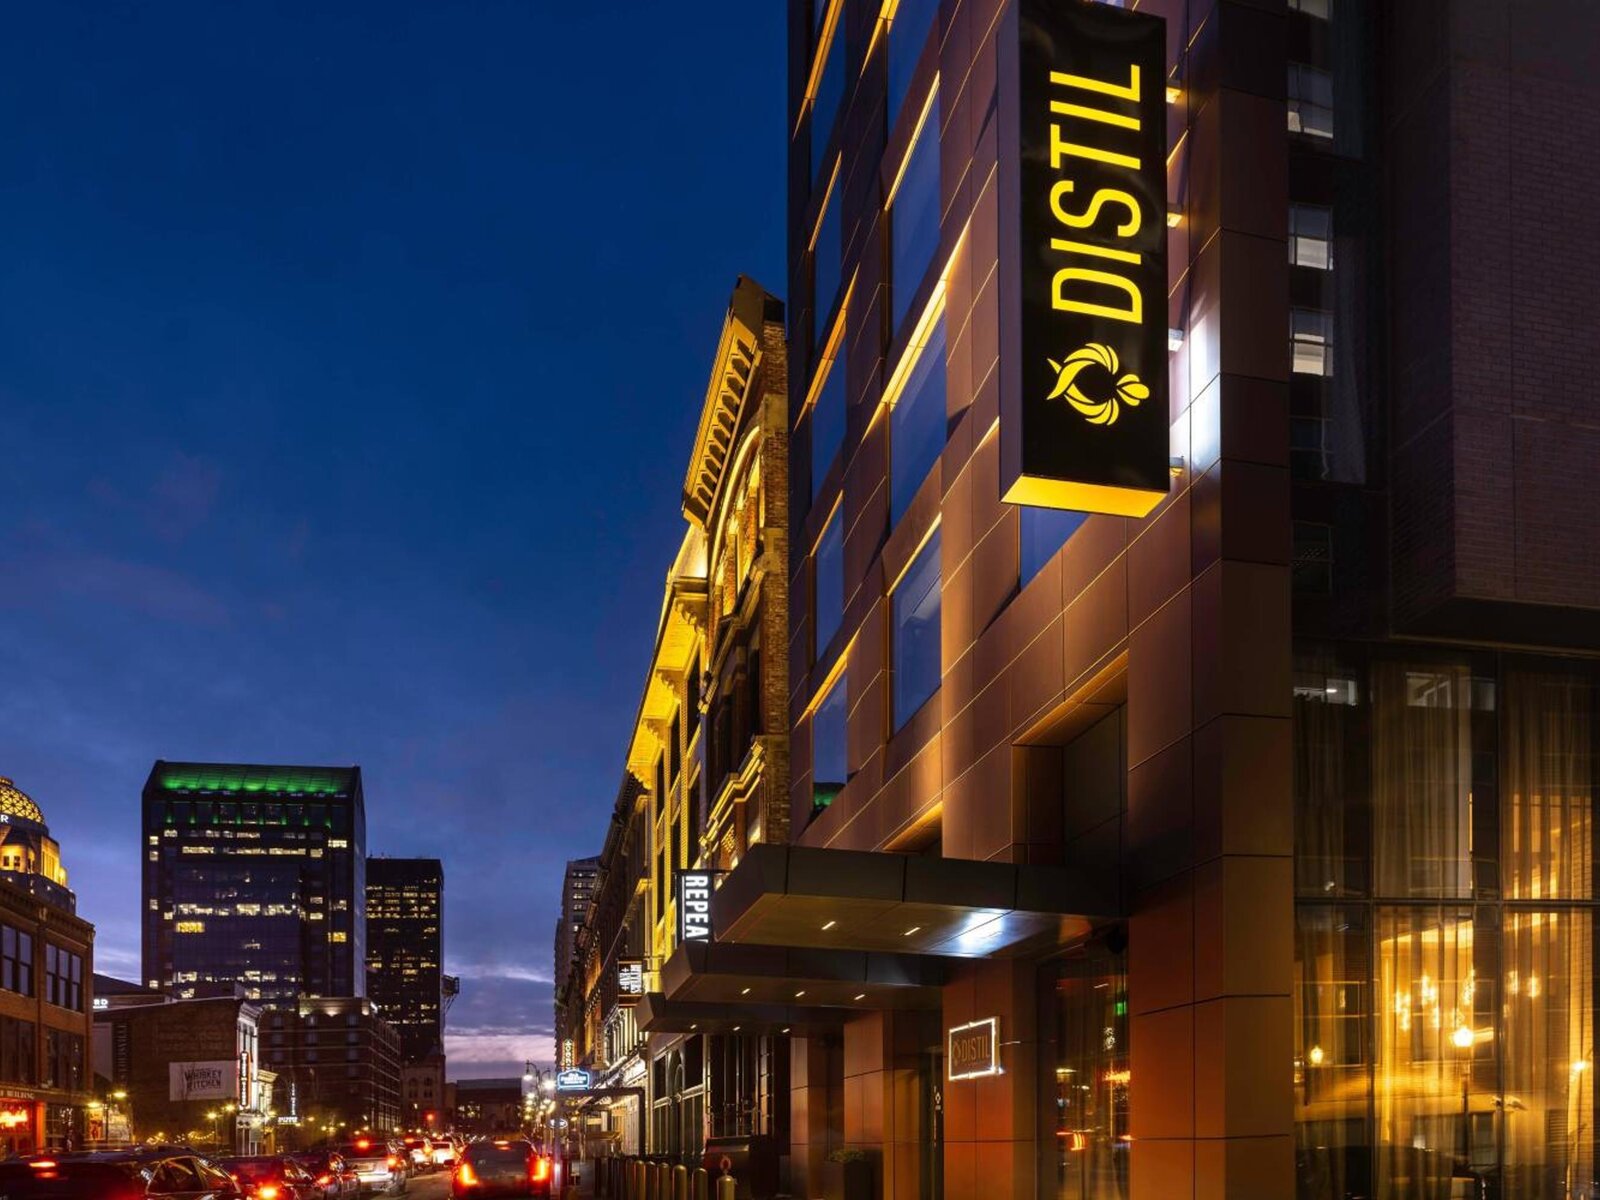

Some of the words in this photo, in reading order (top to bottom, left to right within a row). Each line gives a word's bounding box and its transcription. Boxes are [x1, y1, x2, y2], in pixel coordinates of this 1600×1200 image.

[1049, 63, 1143, 325] DISTIL
[961, 1033, 990, 1062] DISTIL
[184, 1069, 222, 1081] WHISKEY
[187, 1079, 221, 1091] KITCHEN
